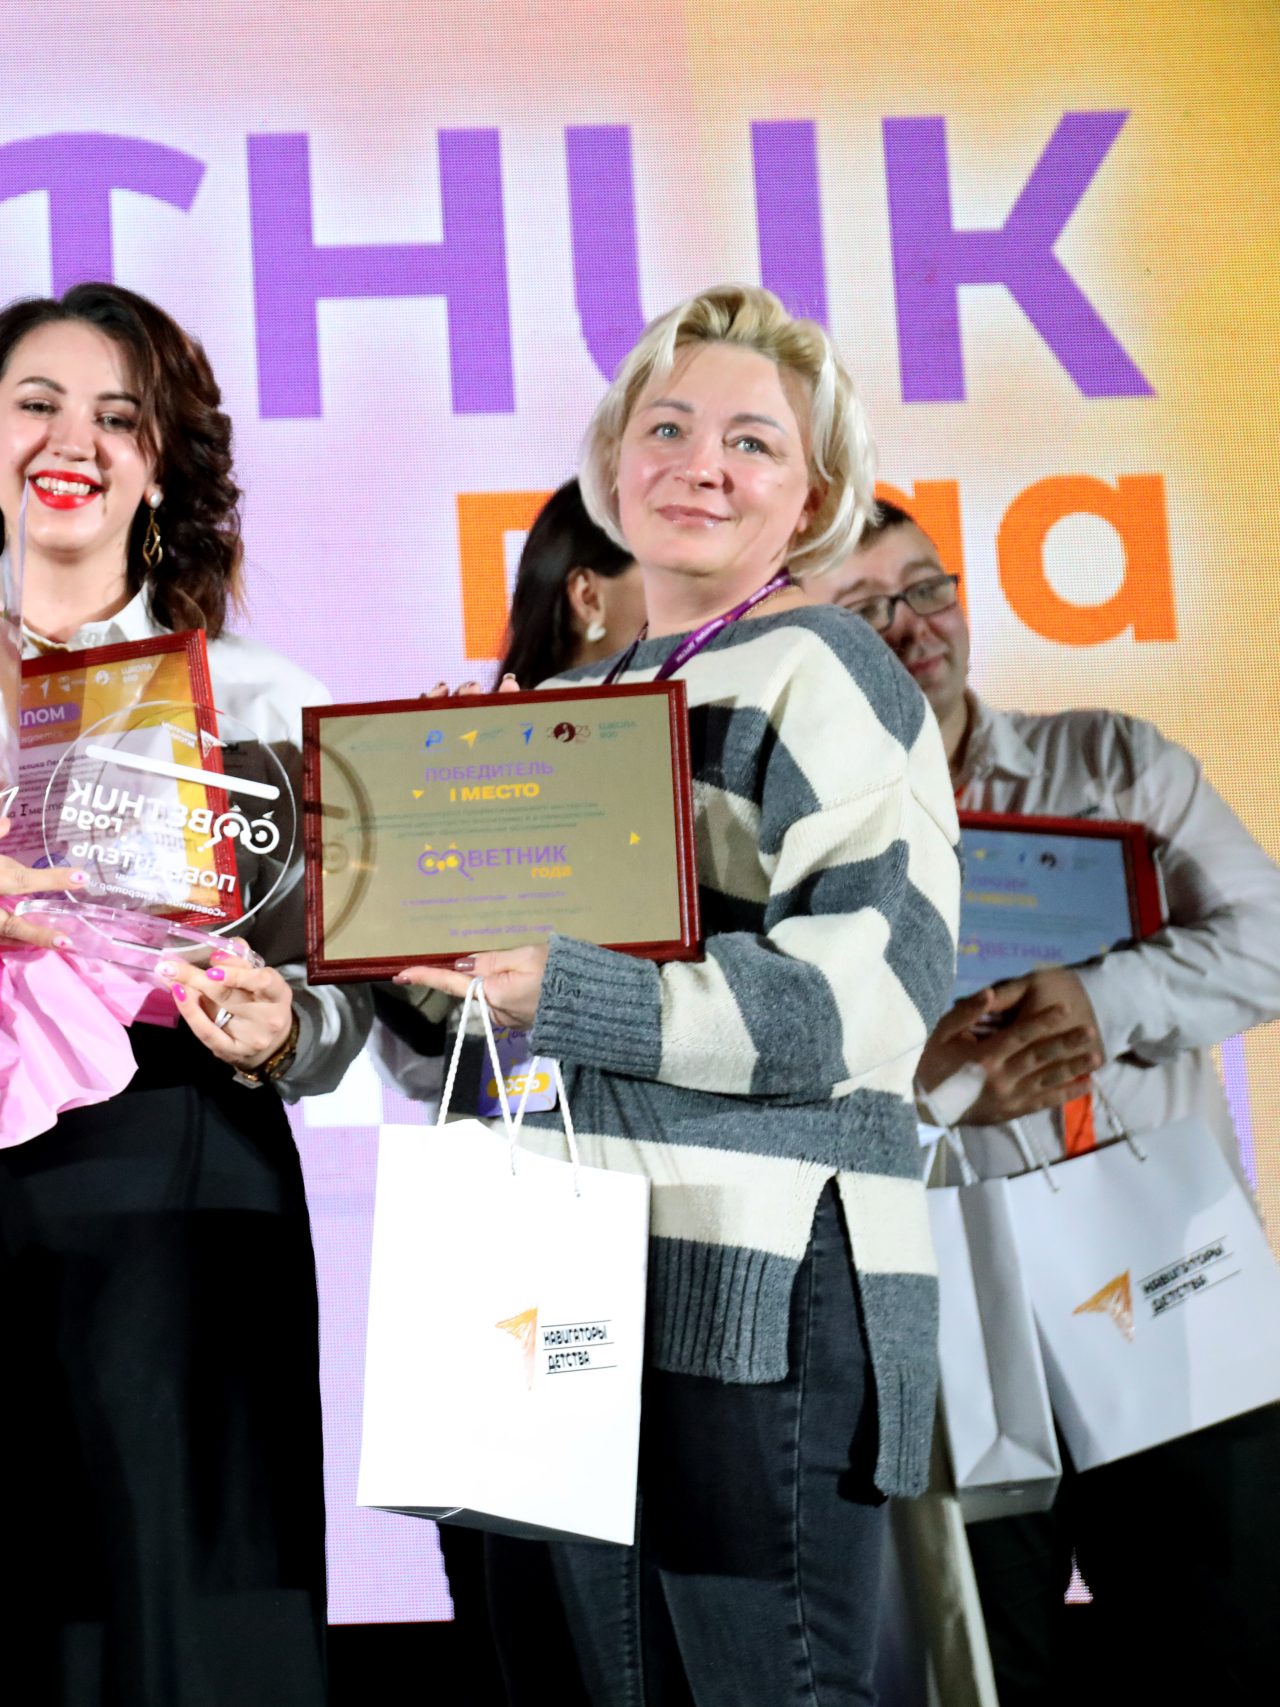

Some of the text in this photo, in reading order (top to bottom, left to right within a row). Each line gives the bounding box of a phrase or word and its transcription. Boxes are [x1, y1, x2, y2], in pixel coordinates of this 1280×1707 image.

[20, 705, 65, 726] ЛОМ
[424, 761, 554, 783] ПОБЕДИТЕЛЬ
[450, 782, 540, 802] I МЕСТО
[417, 845, 567, 879] СОВЕТНИК
[531, 865, 573, 878] года
[1142, 1242, 1225, 1294] НАВИГАТОРЫ
[1151, 1274, 1208, 1313] ДЕТСТВА
[543, 1325, 608, 1346] НАВИГАТОРЫ
[548, 1350, 591, 1373] ДЕТСТВА
